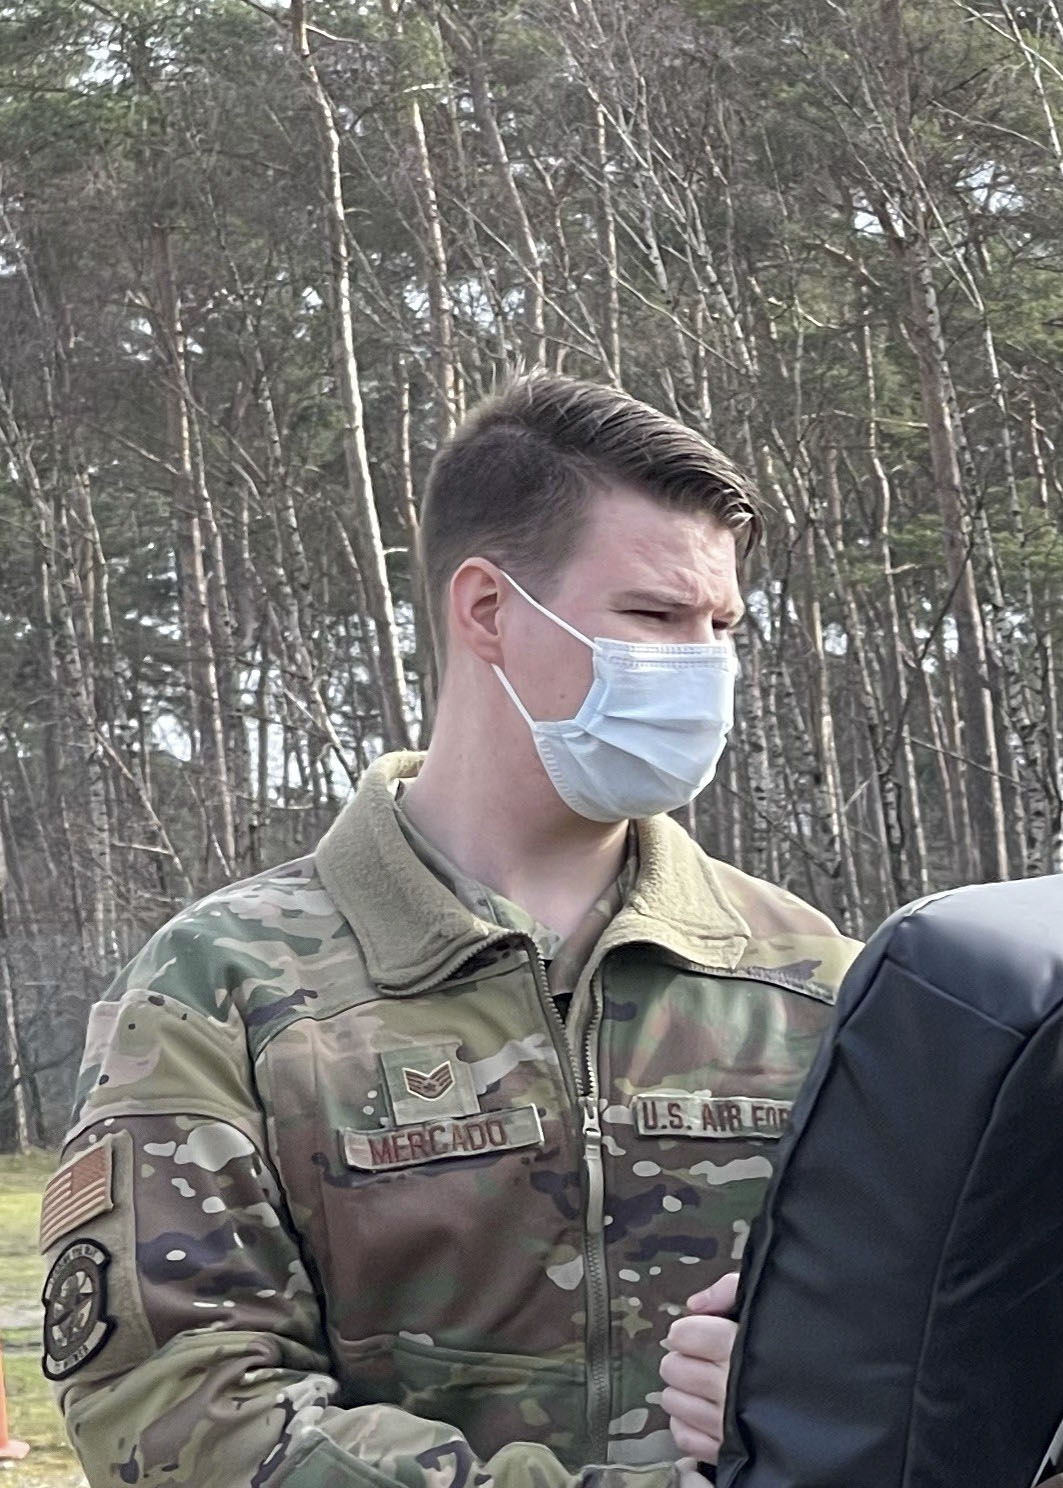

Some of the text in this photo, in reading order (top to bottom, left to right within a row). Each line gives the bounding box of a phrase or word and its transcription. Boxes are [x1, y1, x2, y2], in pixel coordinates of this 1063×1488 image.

[642, 1101, 791, 1132] U.S. AIR FOR
[368, 1119, 507, 1166] MERCADO
